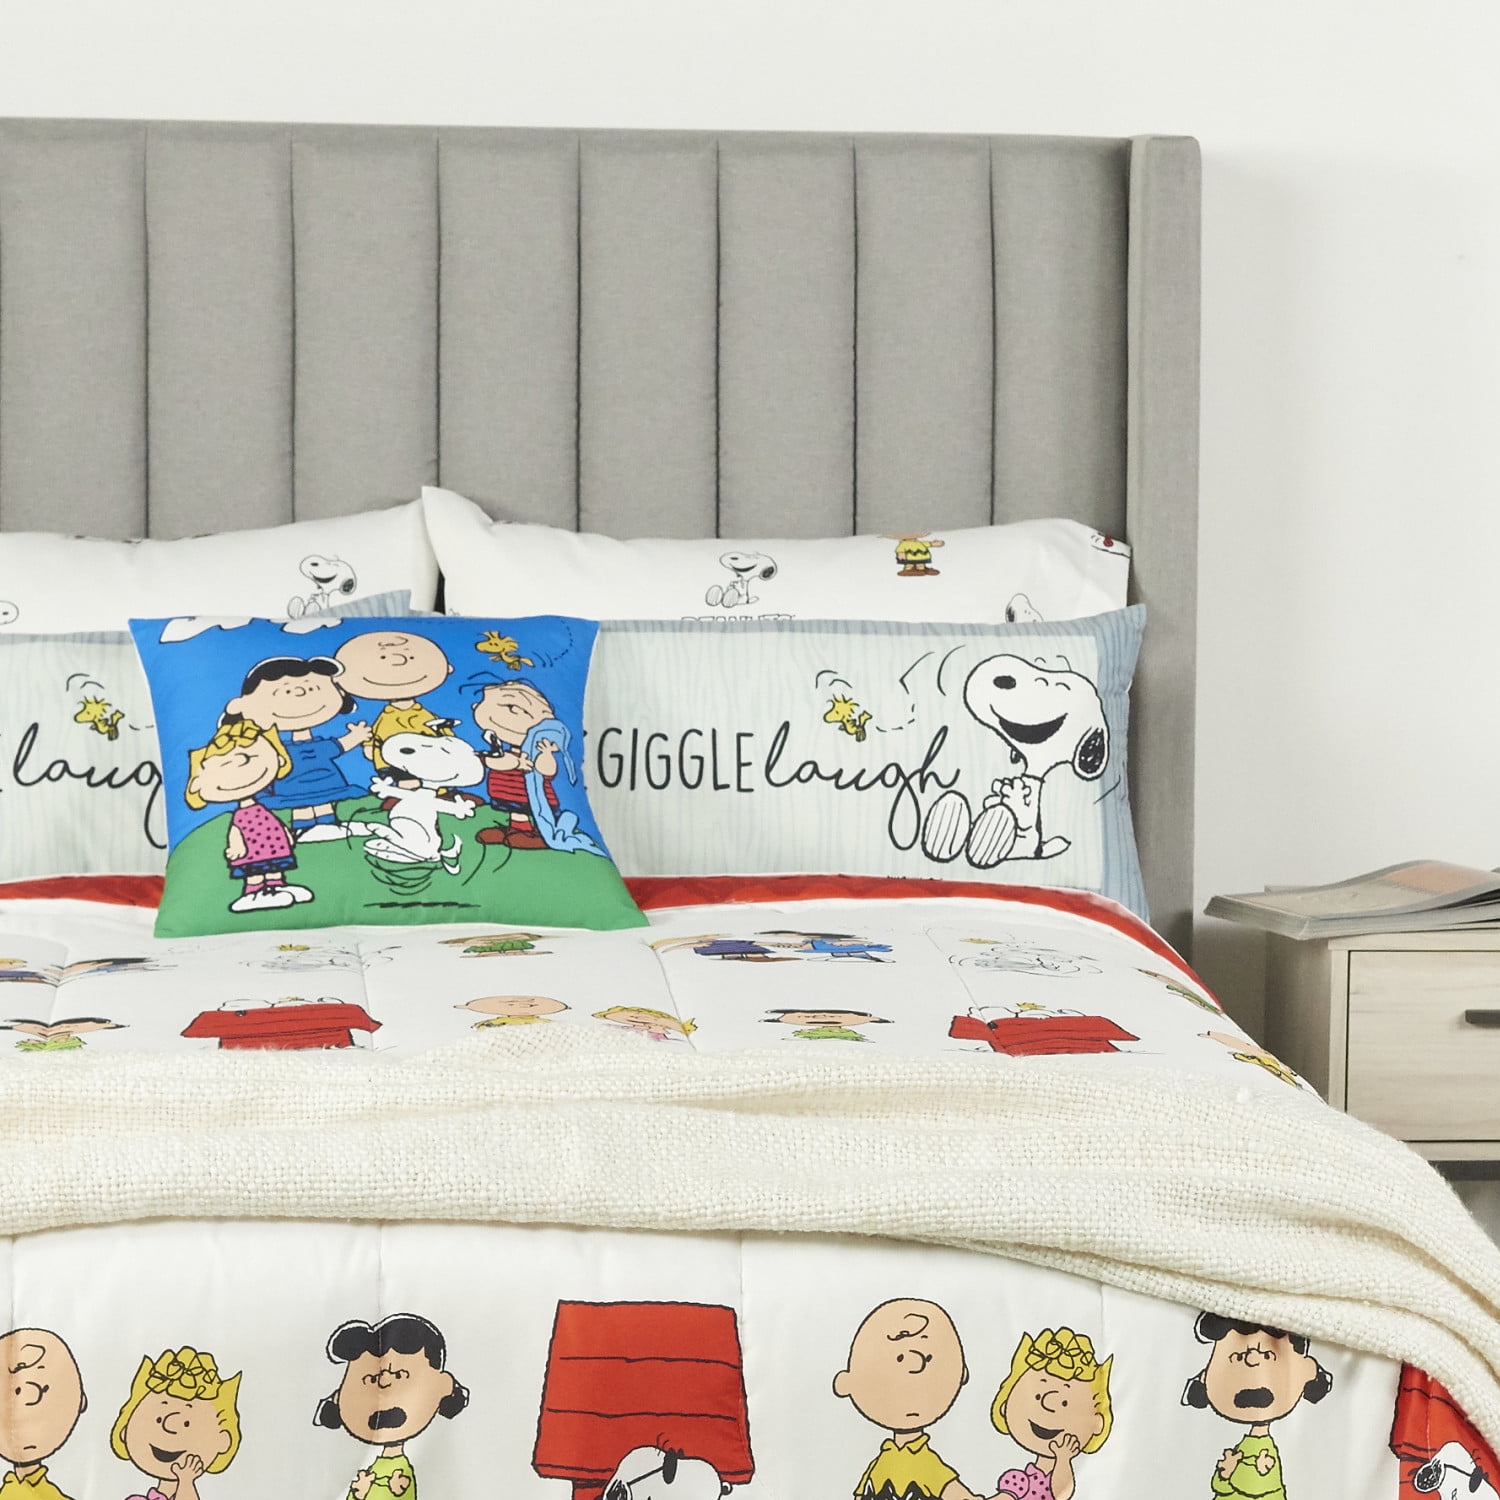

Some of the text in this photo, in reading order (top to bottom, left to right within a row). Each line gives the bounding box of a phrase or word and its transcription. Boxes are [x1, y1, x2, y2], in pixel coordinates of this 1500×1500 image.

[13, 722, 168, 850] laug
[597, 720, 962, 852] GIGGLE laugh
